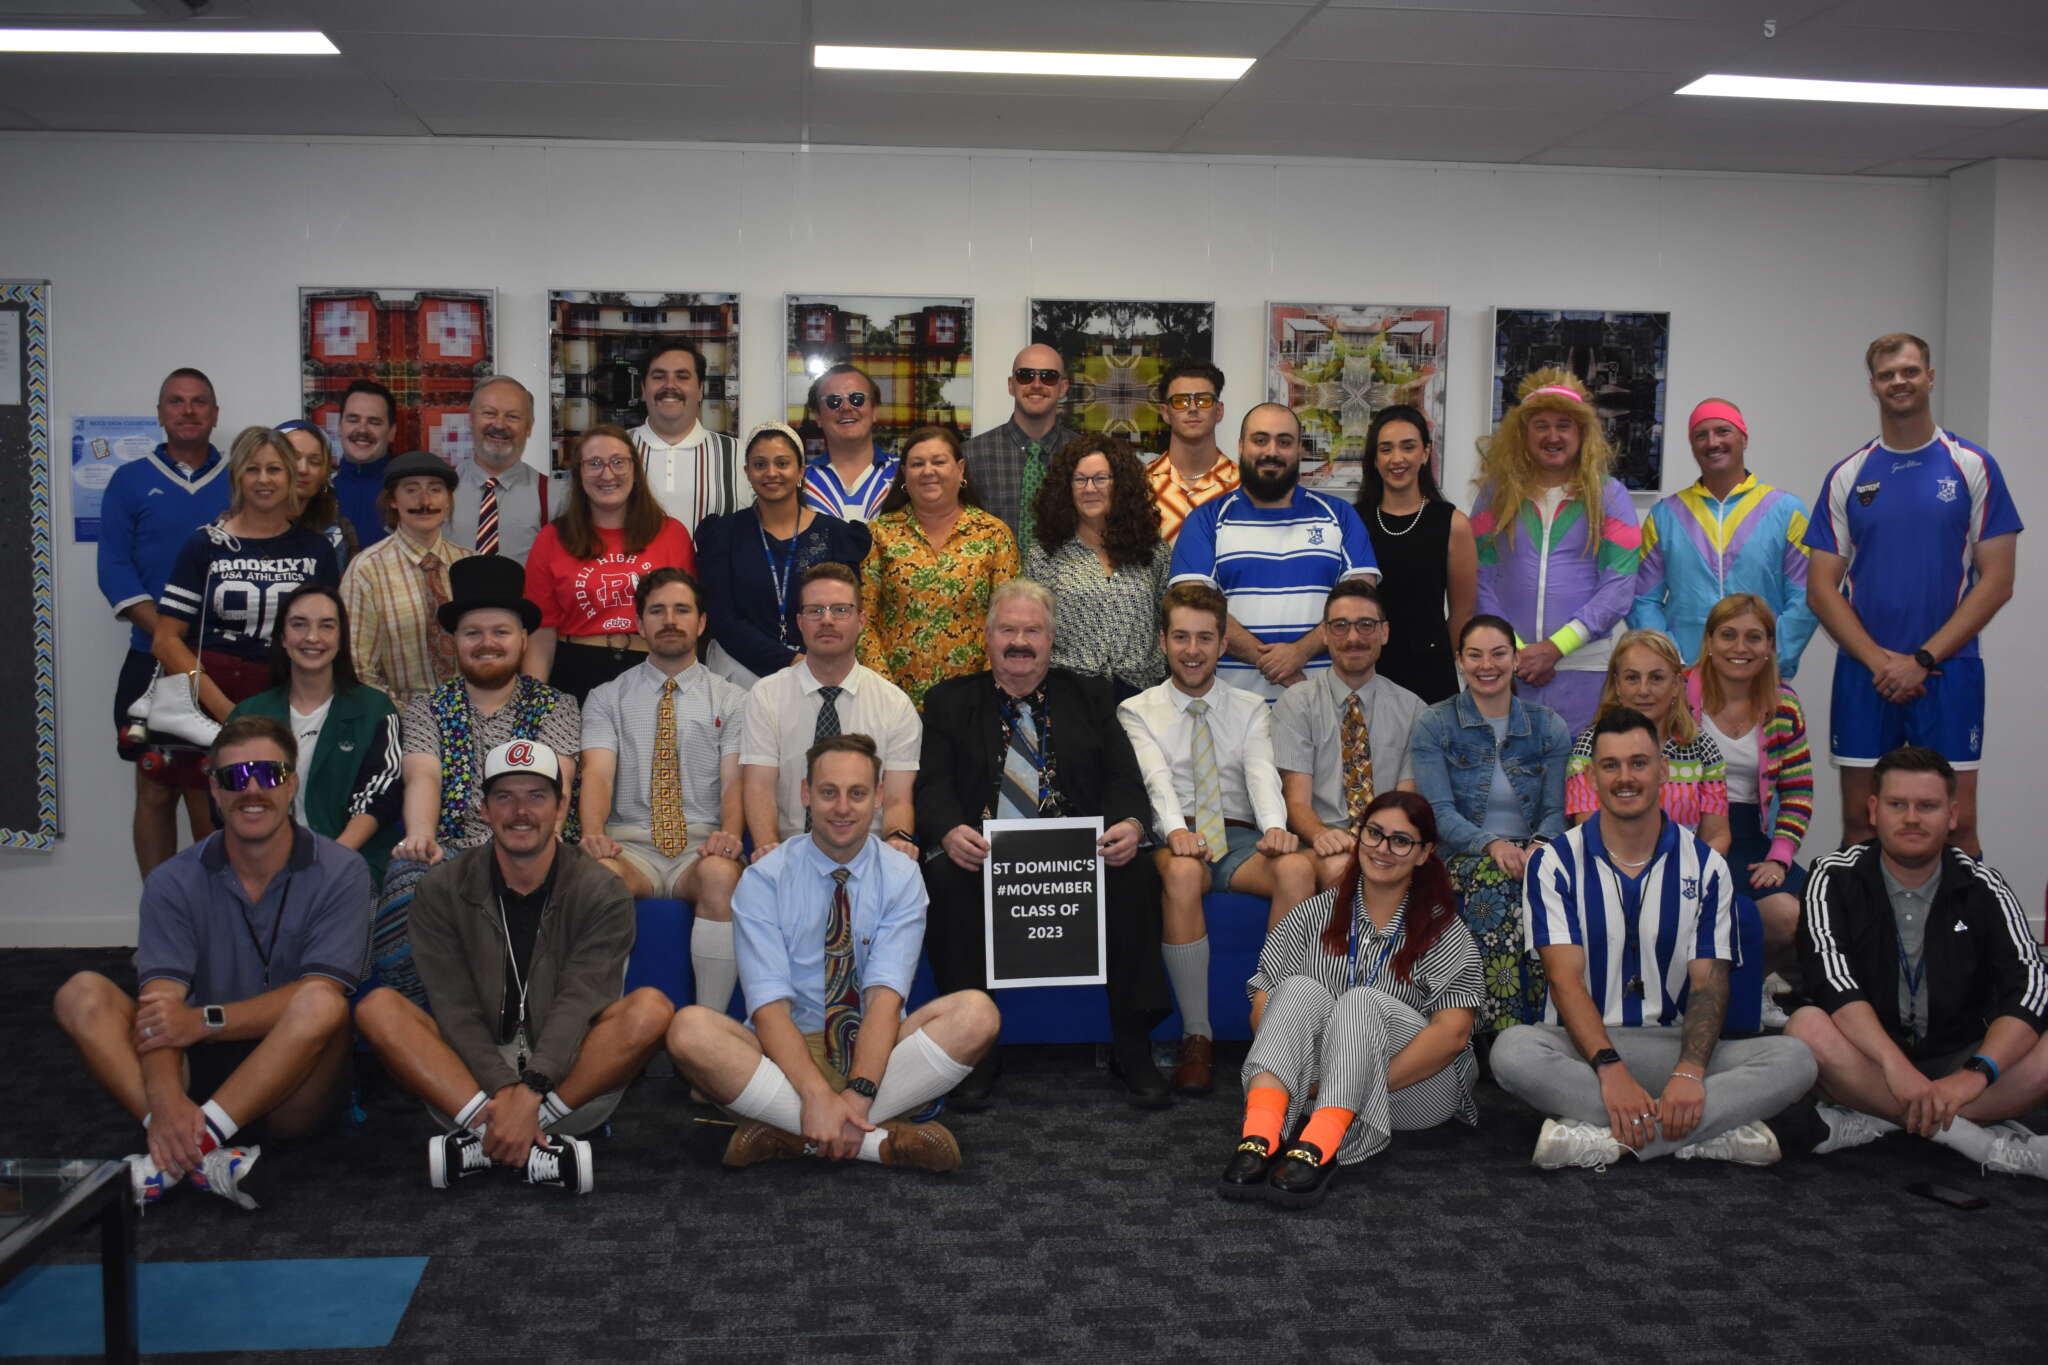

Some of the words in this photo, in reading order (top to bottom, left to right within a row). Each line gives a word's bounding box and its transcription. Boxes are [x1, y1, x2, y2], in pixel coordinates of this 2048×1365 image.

[220, 570, 243, 580] USA
[246, 571, 305, 582] ATHLETICS
[575, 566, 597, 619] RYDELL
[596, 553, 638, 565] HIGH
[992, 862, 1011, 875] ST
[1015, 859, 1096, 874] DOMINIC'S
[996, 881, 1093, 896] #MOVEMBER
[1010, 904, 1056, 918] CLASS
[1060, 903, 1080, 916] OF
[1027, 926, 1063, 939] 2023
